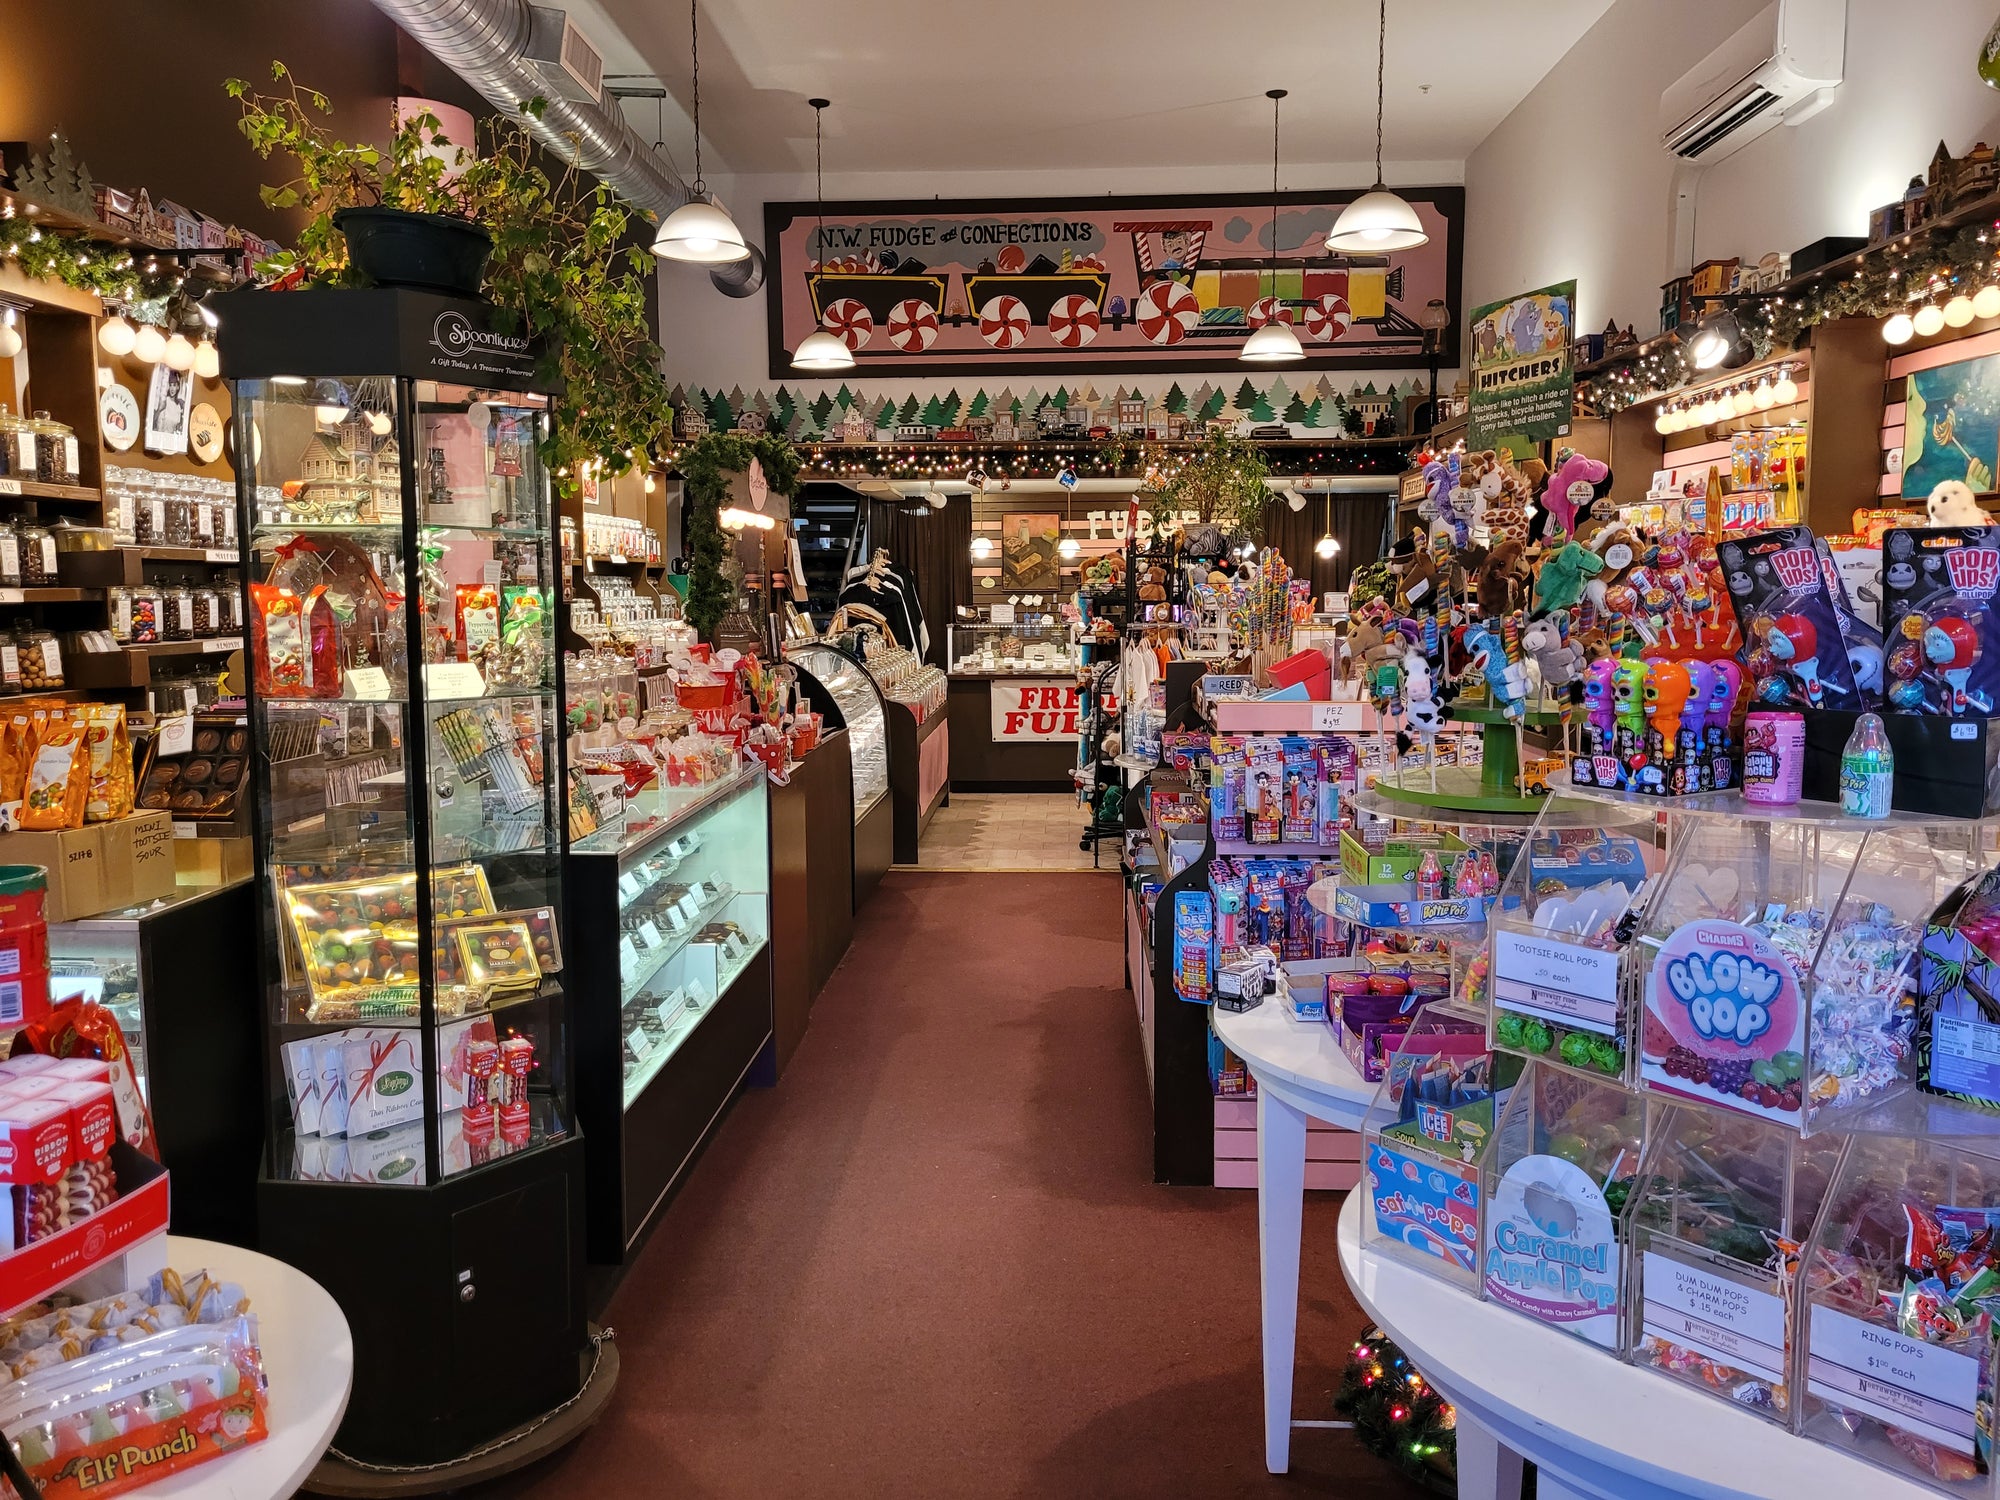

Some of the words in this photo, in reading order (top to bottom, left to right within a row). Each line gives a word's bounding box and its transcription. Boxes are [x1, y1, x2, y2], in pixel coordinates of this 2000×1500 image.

[816, 228, 862, 248] N.W.
[869, 226, 936, 246] FUDGE
[940, 226, 958, 243] and
[961, 223, 1093, 244] CONFECTIONS
[449, 323, 530, 350] Spoontiques
[430, 357, 437, 365] A
[438, 358, 450, 367] Gift
[451, 360, 471, 370] Today,
[479, 363, 504, 374] Treasure
[1500, 399, 1512, 408] like
[1513, 397, 1520, 406] to
[1521, 394, 1537, 404] hitch
[1544, 389, 1558, 399] ride
[1559, 388, 1569, 397] on
[1475, 410, 1510, 423] backpacks,
[1511, 404, 1534, 417] bicycle
[1535, 399, 1564, 411] handles,
[1480, 422, 1496, 433] pony
[1497, 419, 1512, 428] tails,
[1513, 416, 1526, 425] and
[1527, 411, 1557, 423] strollers.
[1326, 706, 1343, 715] PEZ
[1323, 755, 1350, 767] PEZ
[134, 820, 165, 835] MINI
[133, 831, 171, 848] TOOTSIE
[136, 846, 166, 863] SOUR
[1381, 863, 1392, 873] 12
[1253, 880, 1280, 893] PEZ
[1284, 874, 1308, 886] PEZ
[1183, 913, 1207, 924] PEZ
[1698, 931, 1743, 946] CHARMS
[1514, 943, 1551, 959] TOOTSIE
[1553, 951, 1574, 964] ROLL
[1576, 956, 1598, 968] POPS
[1552, 973, 1571, 983] each
[1668, 953, 1780, 1003] BLOW
[1691, 996, 1767, 1041] POP
[1940, 1023, 1958, 1032] Facts
[81, 1114, 111, 1137] RIBBON
[83, 1124, 110, 1145] CANDY
[1422, 1112, 1448, 1135] ICEE
[34, 1134, 69, 1157] RIBBON
[1395, 1131, 1417, 1145] SOUR
[36, 1145, 67, 1166] CANDY
[51, 1249, 80, 1269] RIBBON
[108, 1220, 133, 1239] CANDY
[1495, 1221, 1609, 1274] Caramel
[1486, 1247, 1561, 1289] Apple
[1562, 1263, 1616, 1310] Pop
[1675, 1271, 1697, 1286] DUM
[1699, 1280, 1722, 1295] DUM
[1724, 1288, 1750, 1305] POPS
[1486, 1278, 1502, 1297] Green
[1502, 1292, 1521, 1306] Apple
[1521, 1300, 1541, 1314] Candy
[1541, 1305, 1555, 1315] with
[1555, 1308, 1573, 1318] Chewy
[1677, 1283, 1683, 1292] &
[1686, 1286, 1720, 1305] CHARM
[1722, 1299, 1747, 1315] POPS
[1689, 1298, 1696, 1308] $
[1699, 1302, 1711, 1313] .15
[1713, 1309, 1734, 1321] each
[1861, 1330, 1892, 1347] RING
[1894, 1340, 1924, 1358] POPS
[1891, 1366, 1916, 1381] each
[78, 1452, 119, 1490] Elf
[121, 1426, 198, 1475] Punch
